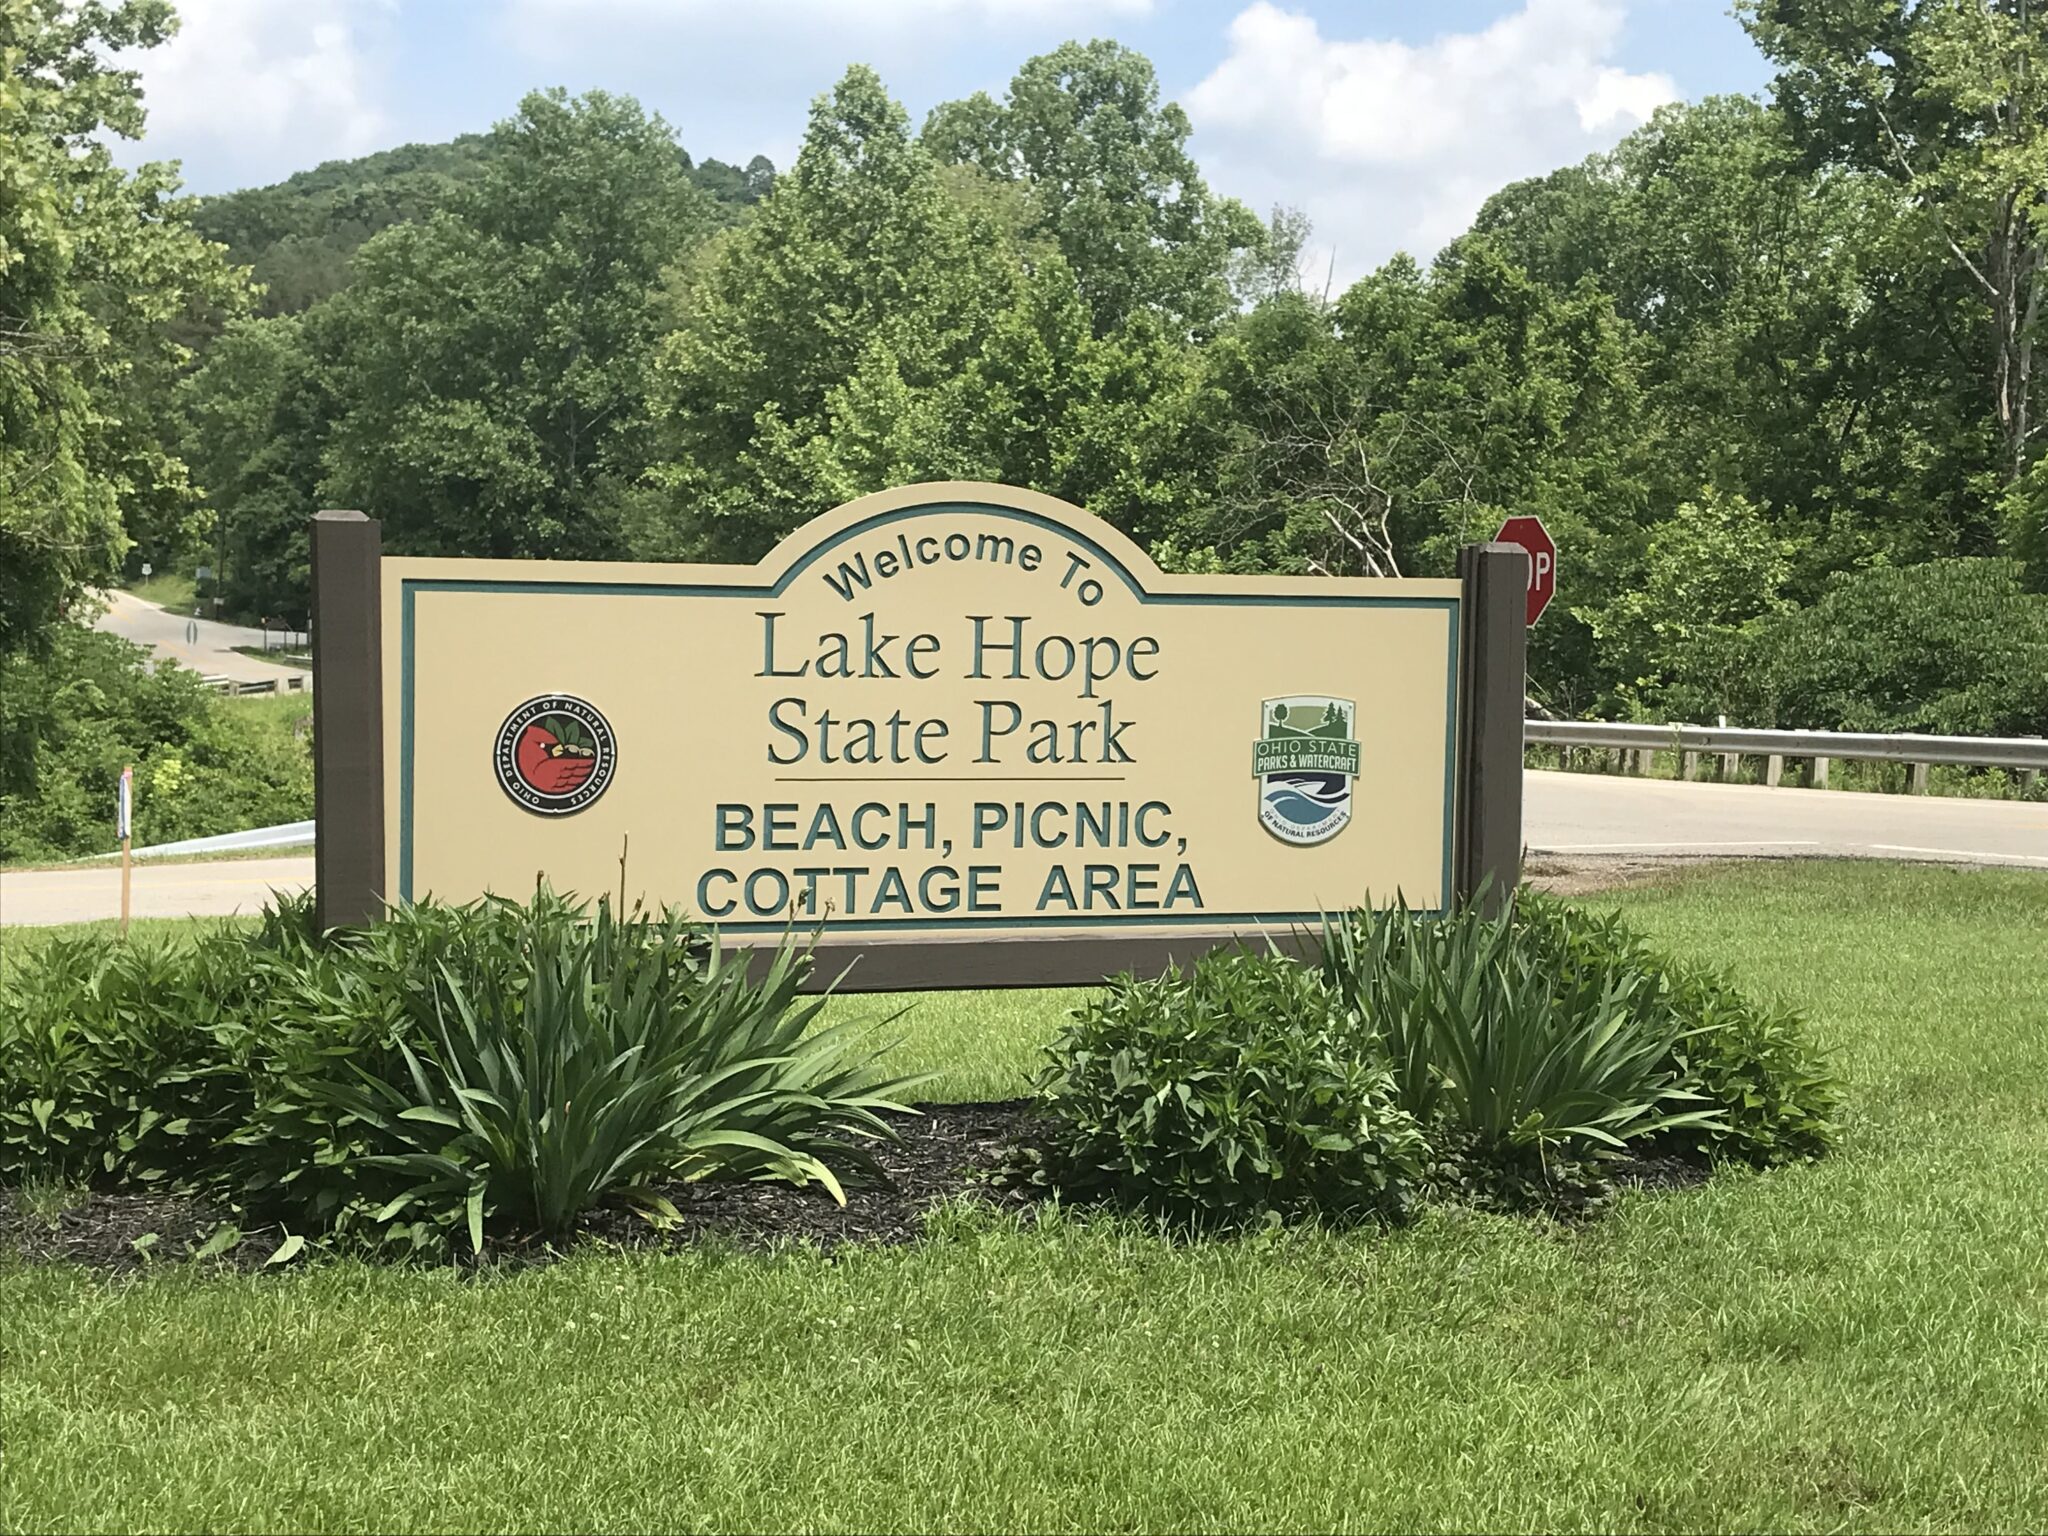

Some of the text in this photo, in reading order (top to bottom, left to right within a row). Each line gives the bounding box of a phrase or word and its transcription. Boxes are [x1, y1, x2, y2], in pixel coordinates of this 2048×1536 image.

[822, 531, 1104, 606] Welcome To
[754, 611, 1160, 699] Lake Hope
[542, 701, 557, 710] OF
[564, 702, 607, 742] NATURAL
[767, 697, 1137, 765] State Park
[502, 707, 536, 777] DEPARTMENT
[1257, 740, 1357, 757] OHIO STATE
[1257, 753, 1357, 772] PARKS & WATERCRAFT
[512, 782, 540, 804] OHIO
[715, 801, 1188, 858] BEACH, PICNIC,
[697, 863, 1204, 917] COTTAGE AREA
